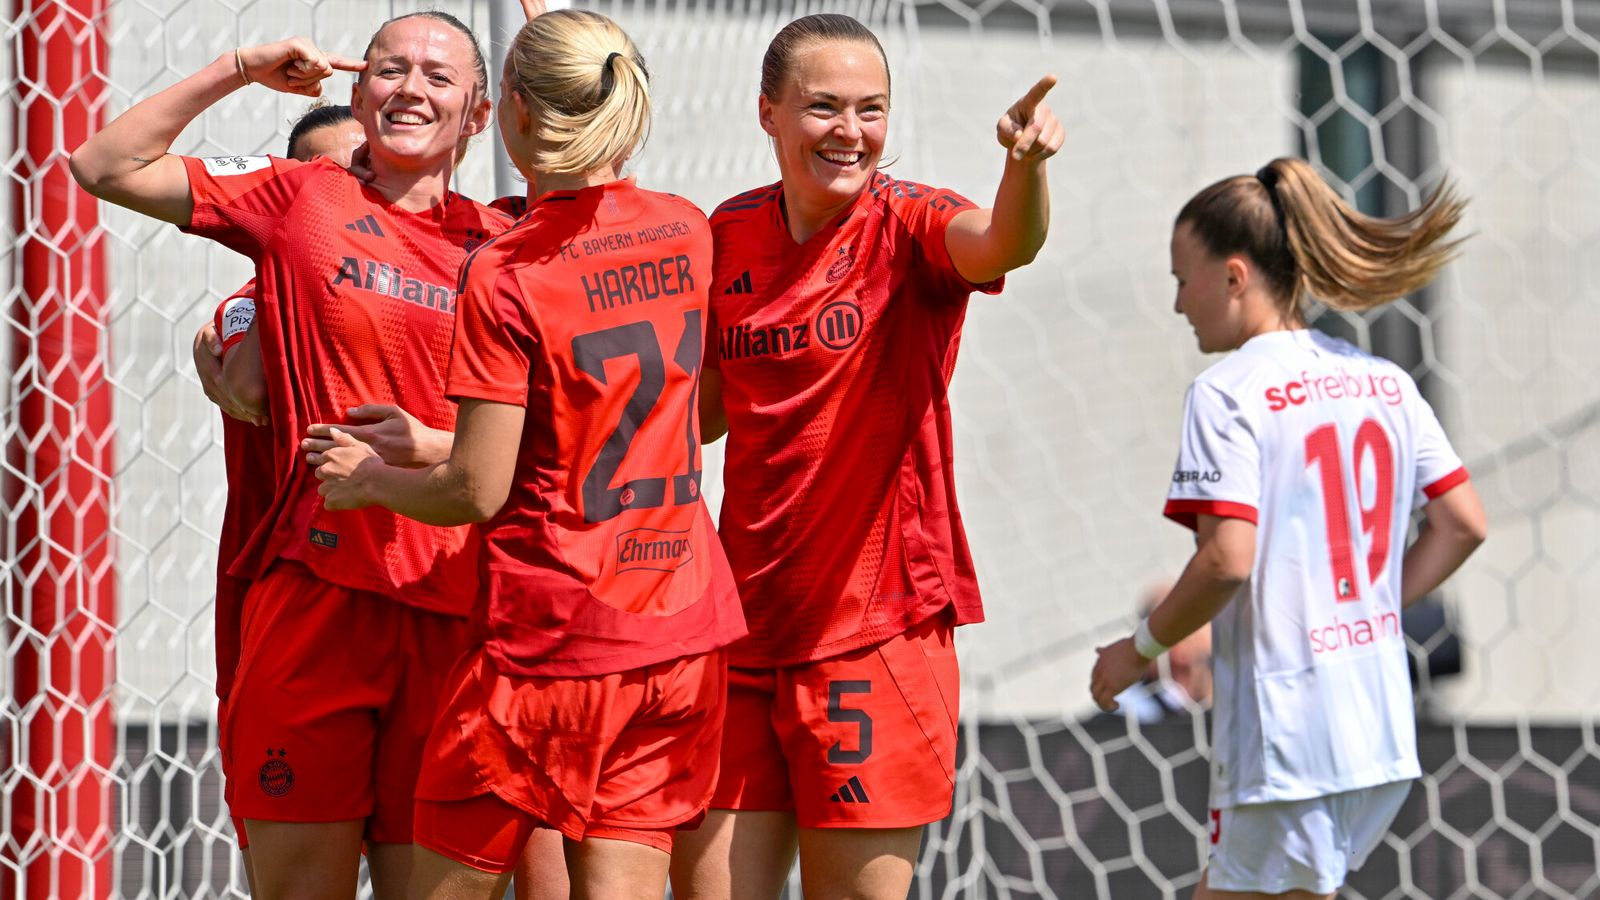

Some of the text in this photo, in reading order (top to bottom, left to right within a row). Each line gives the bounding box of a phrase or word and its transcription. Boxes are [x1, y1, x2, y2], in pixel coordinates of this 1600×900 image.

[560, 243, 579, 262] FC
[582, 232, 634, 256] BAYERN
[226, 306, 256, 318] Goo
[580, 254, 695, 313] HARDER
[571, 308, 702, 525] 21
[1304, 417, 1395, 604] 19
[827, 680, 872, 764] 5
